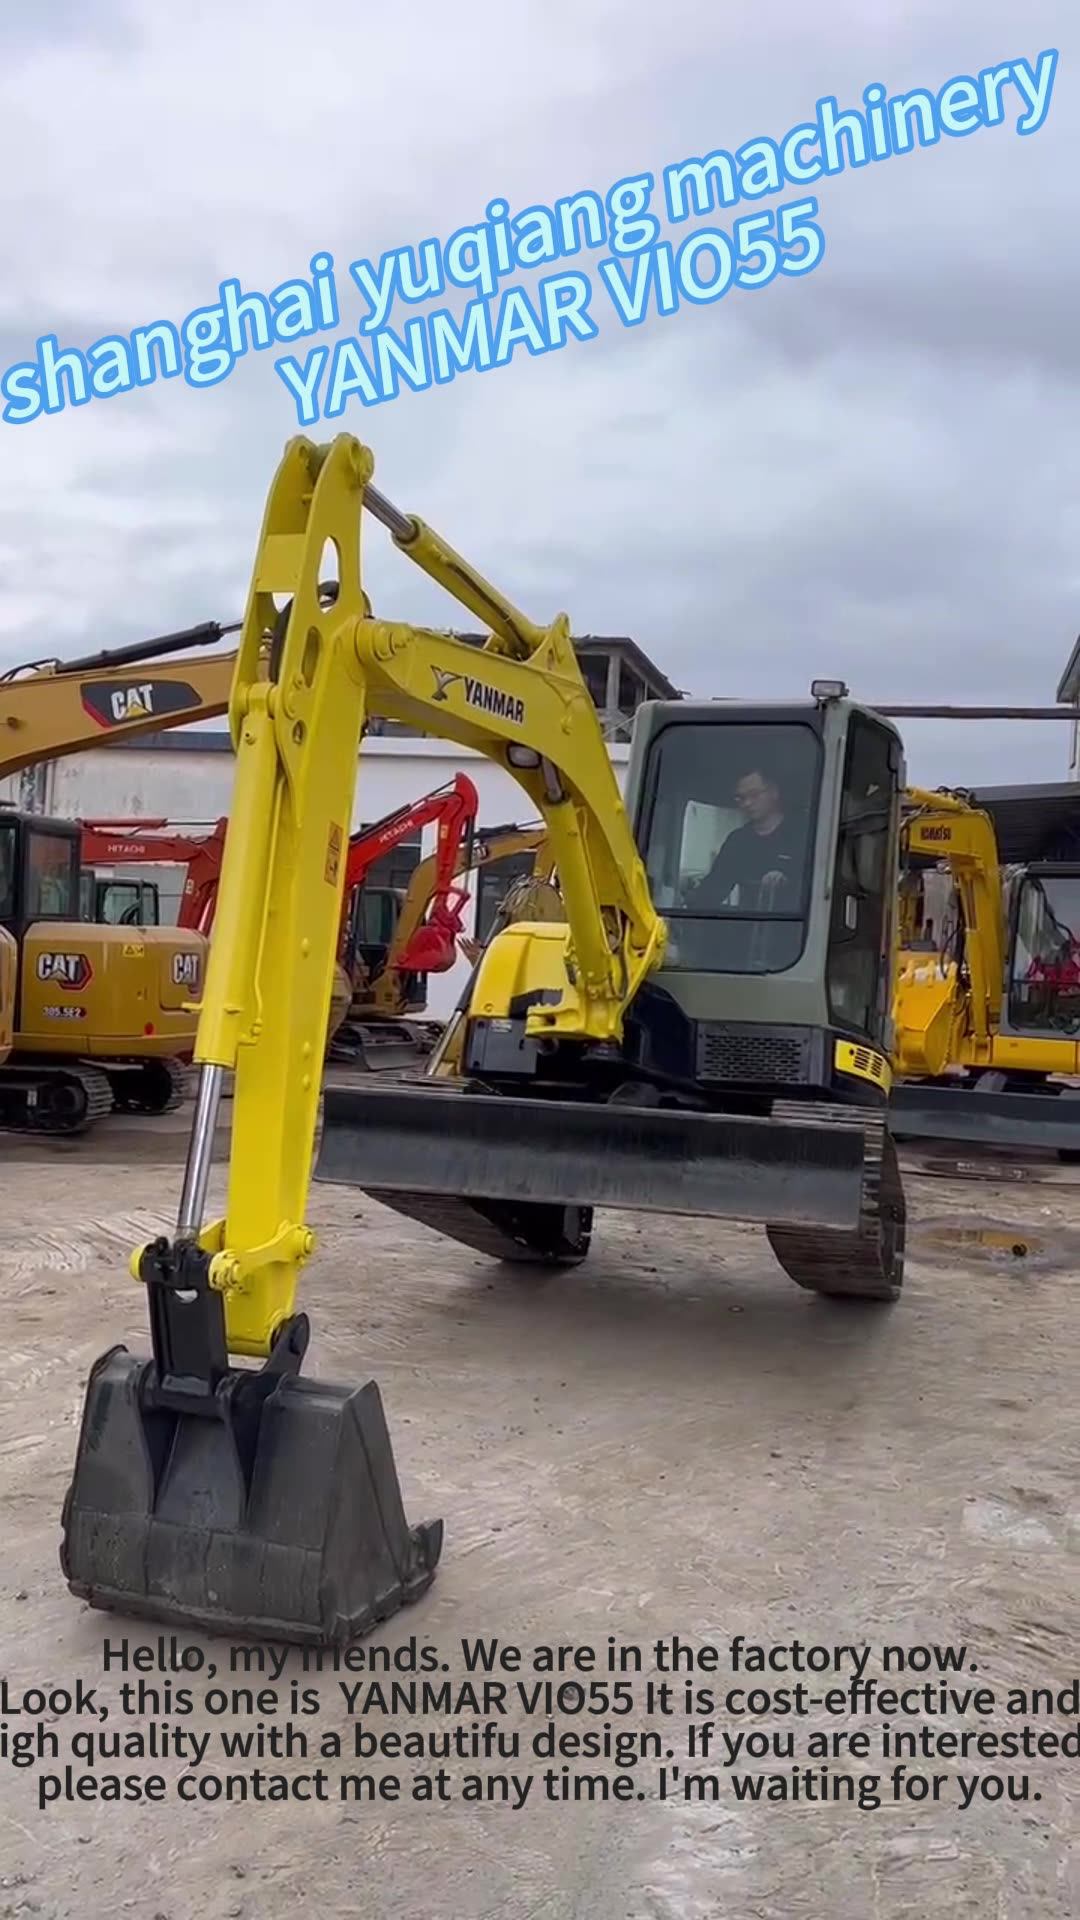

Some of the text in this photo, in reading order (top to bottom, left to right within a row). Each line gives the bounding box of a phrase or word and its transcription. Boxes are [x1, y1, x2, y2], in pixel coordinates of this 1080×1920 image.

[110, 684, 154, 720] CAT
[464, 676, 525, 724] YANMAR
[37, 952, 82, 982] CAT
[172, 953, 200, 984] CAT
